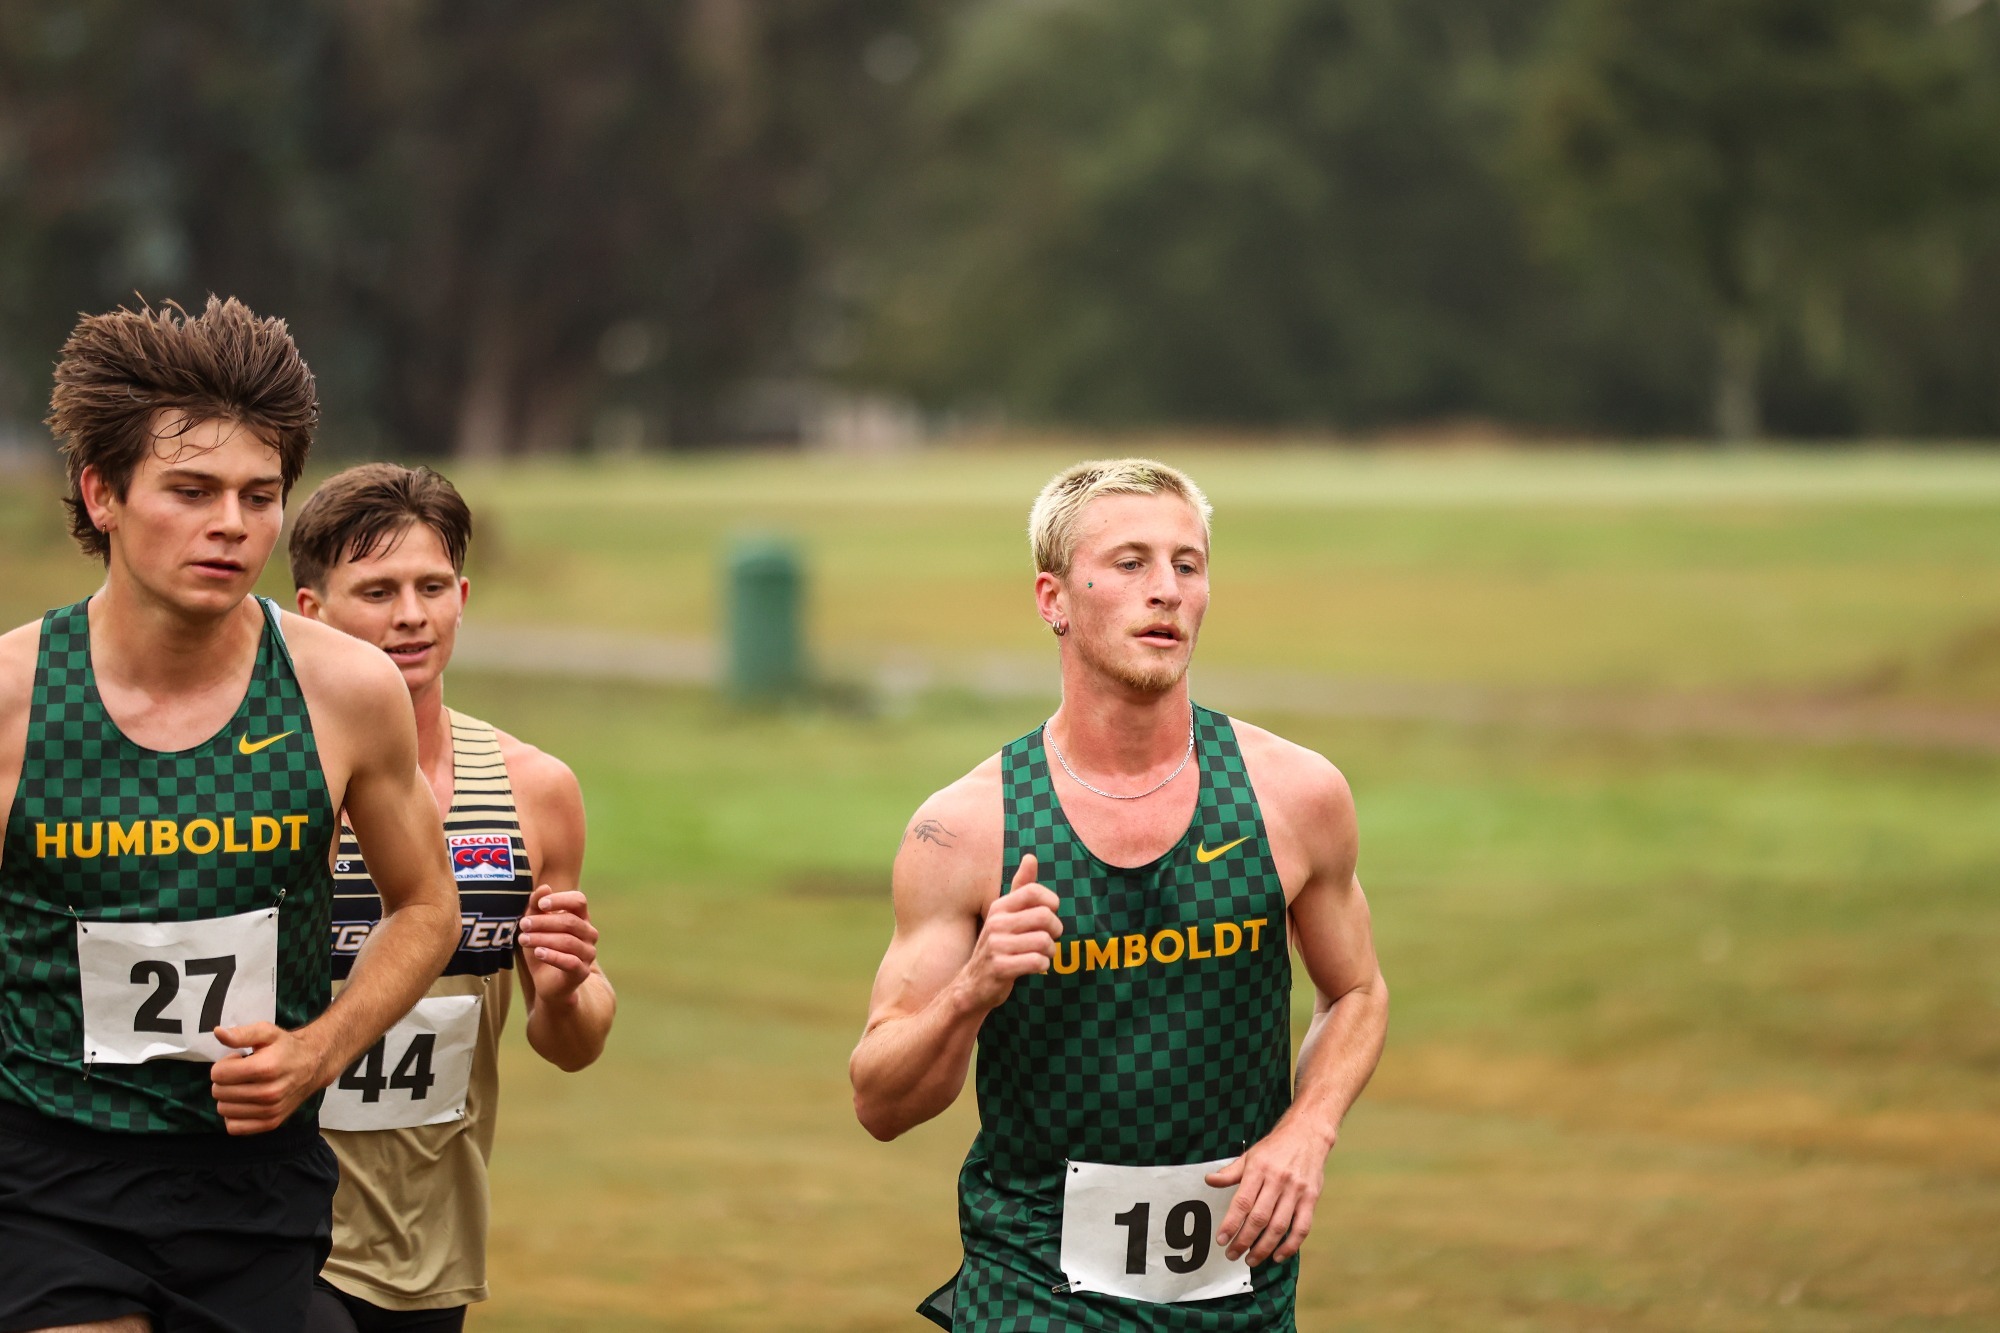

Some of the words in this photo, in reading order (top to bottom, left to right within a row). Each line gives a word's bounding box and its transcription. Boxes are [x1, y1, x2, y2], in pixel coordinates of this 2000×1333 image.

[35, 815, 308, 859] HUMBOLDT
[451, 837, 508, 845] CASCADE
[454, 847, 509, 866] CCC
[1040, 918, 1267, 974] UMBOLDT
[130, 955, 236, 1034] 27
[338, 1034, 436, 1103] 44
[1115, 1200, 1212, 1275] 19
